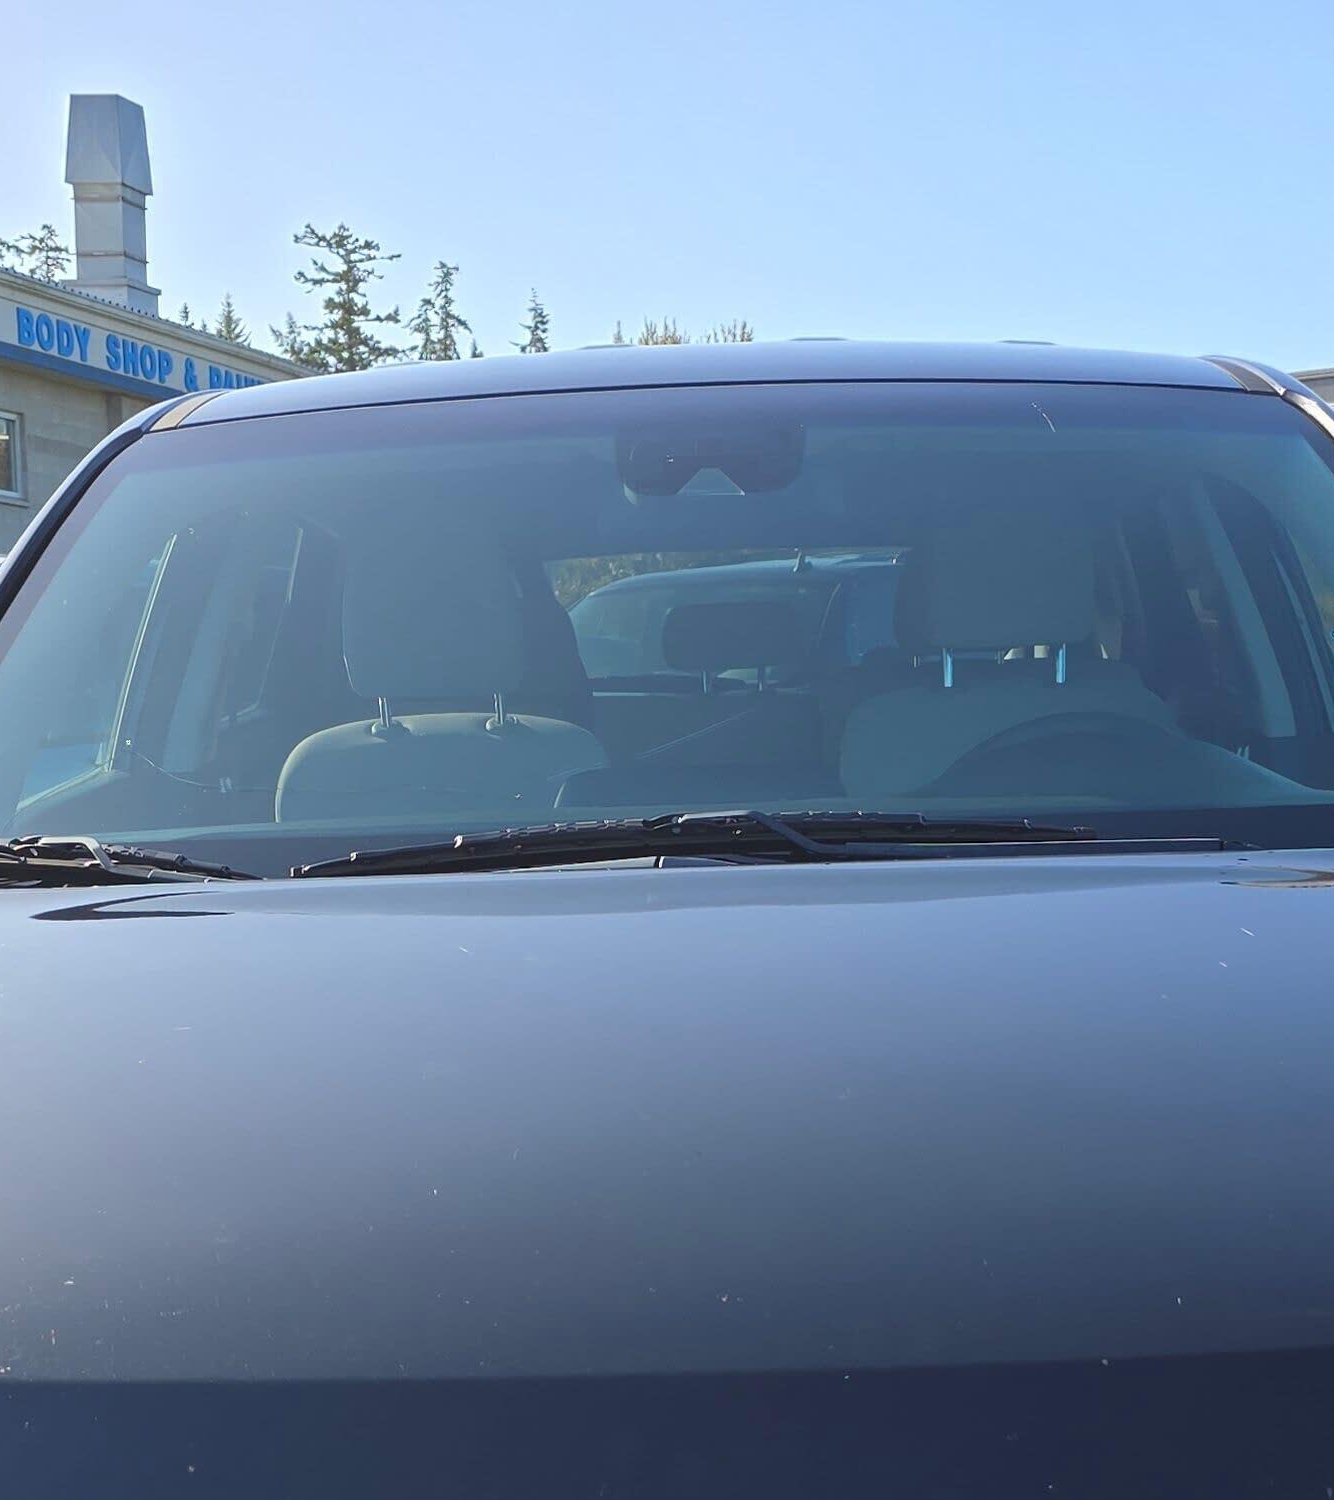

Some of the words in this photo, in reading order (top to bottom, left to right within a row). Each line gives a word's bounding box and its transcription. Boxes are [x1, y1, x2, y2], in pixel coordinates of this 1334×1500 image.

[16, 306, 91, 362] BODY
[105, 333, 173, 384] SHOP
[184, 356, 199, 393] &
